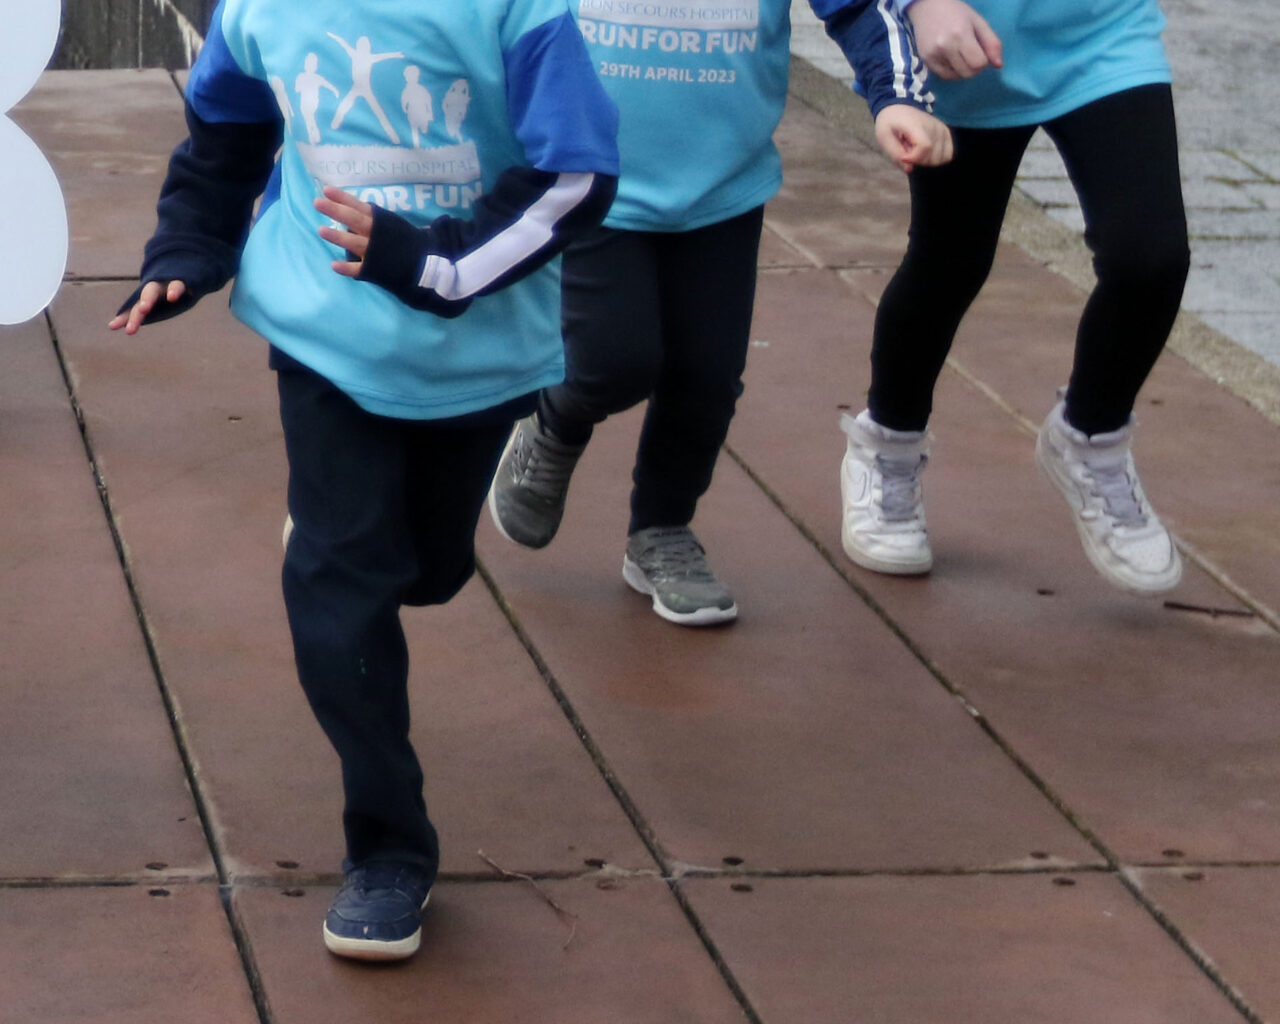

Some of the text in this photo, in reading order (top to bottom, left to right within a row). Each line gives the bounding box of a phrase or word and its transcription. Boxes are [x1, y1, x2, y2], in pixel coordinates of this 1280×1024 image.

[619, 0, 687, 18] SECOURS
[577, 18, 758, 54] RUN FOR FUN
[600, 61, 736, 83] 29TH APRIL 2023
[414, 181, 483, 210] FUN
